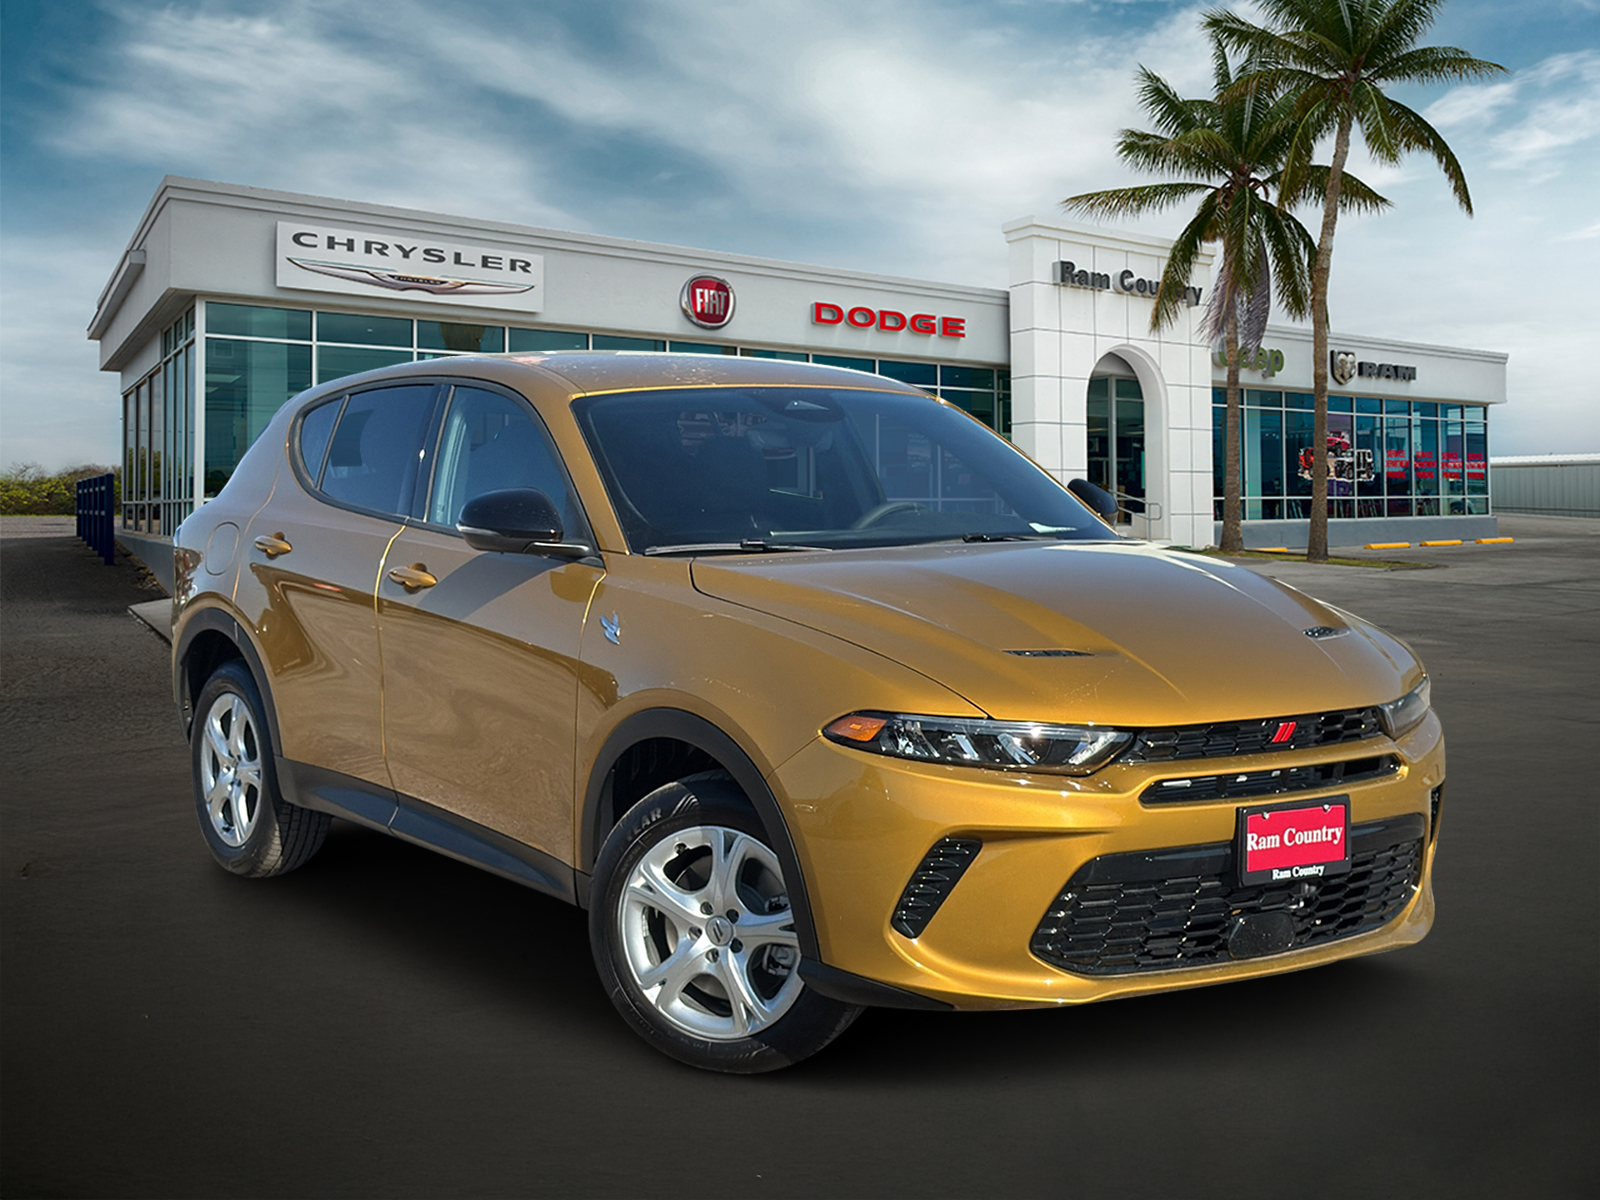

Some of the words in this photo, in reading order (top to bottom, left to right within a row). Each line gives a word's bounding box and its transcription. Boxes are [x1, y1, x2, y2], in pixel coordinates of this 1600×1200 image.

[291, 232, 532, 274] CHRYSLER
[1056, 260, 1110, 290] Ram
[1117, 269, 1203, 306] Coury
[695, 288, 727, 316] FIAT
[811, 301, 966, 338] DODGE
[1357, 361, 1417, 381] RAM
[1247, 833, 1280, 851] Ram
[1283, 825, 1343, 846] Country
[1272, 868, 1291, 880] Ram
[1292, 865, 1325, 877] Country
